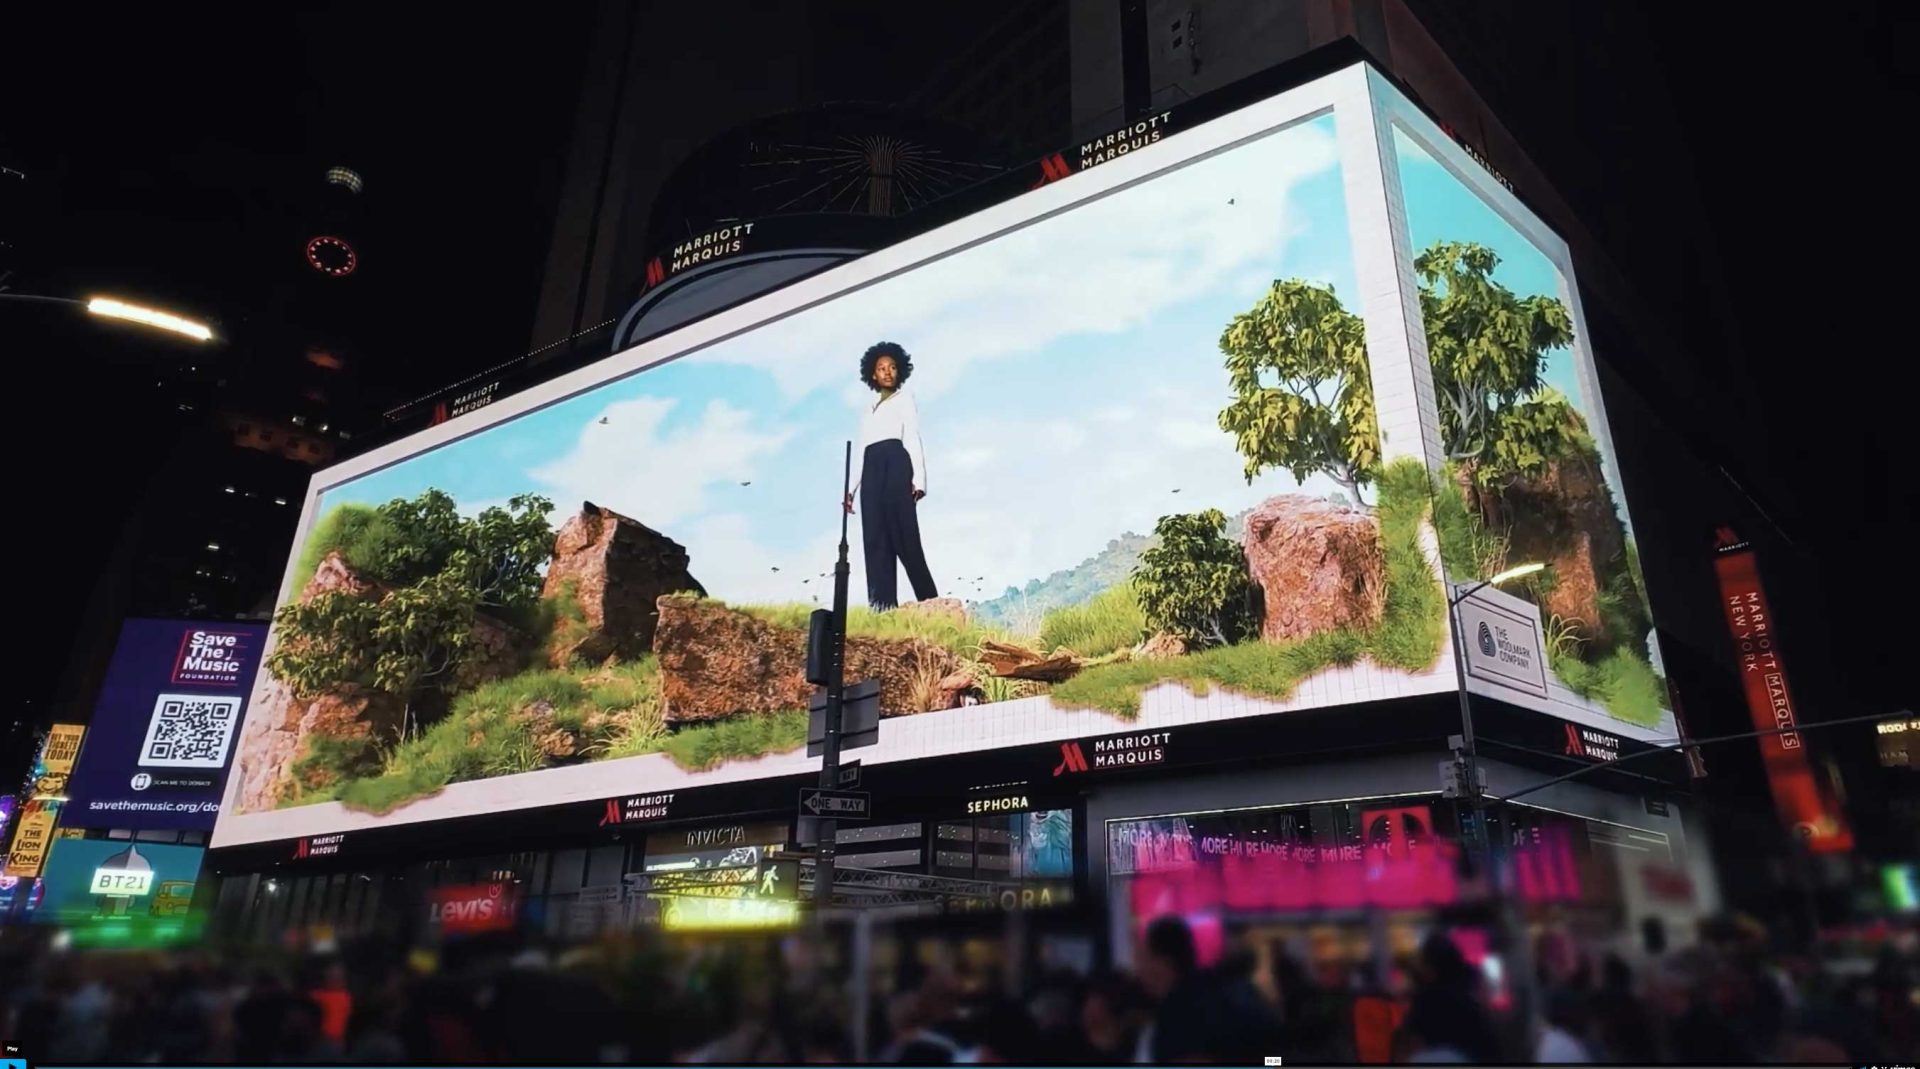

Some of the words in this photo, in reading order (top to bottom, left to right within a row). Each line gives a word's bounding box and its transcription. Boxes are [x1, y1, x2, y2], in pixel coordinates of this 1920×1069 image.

[1081, 111, 1171, 156] MARRIOTT
[1081, 131, 1160, 169] MARQUIS
[673, 223, 754, 258] MARRIOTT
[671, 240, 741, 273] MARQUIS
[454, 381, 500, 406] MARRIOTT
[452, 395, 492, 417] MARQUIS
[1495, 625, 1508, 641] THE
[1730, 595, 1746, 627] NEW
[1739, 631, 1758, 672] YORK
[1746, 591, 1776, 669] MARRIOTT
[191, 631, 237, 647] Save
[189, 643, 225, 659] The
[182, 656, 240, 672] Music
[1500, 651, 1529, 669] COMPANY
[180, 673, 237, 681] FOUNDATION
[1095, 732, 1171, 752] MARRIOTT
[1582, 730, 1619, 749] MARRIOTT
[45, 749, 76, 761] TODAY
[1096, 749, 1162, 767] MARQUIS
[627, 794, 675, 808] MARRIOTT
[811, 797, 831, 809] ONE
[840, 799, 861, 810] WAY
[967, 796, 1029, 813] SEPHORA
[625, 807, 668, 820] MARQUIS
[24, 829, 43, 837] THE
[312, 834, 344, 845] MARRIOTT
[686, 825, 745, 847] INVICTA
[15, 839, 41, 851] LION
[310, 845, 338, 856] MARQUIS
[8, 852, 40, 865] KING
[99, 874, 145, 889] BT21
